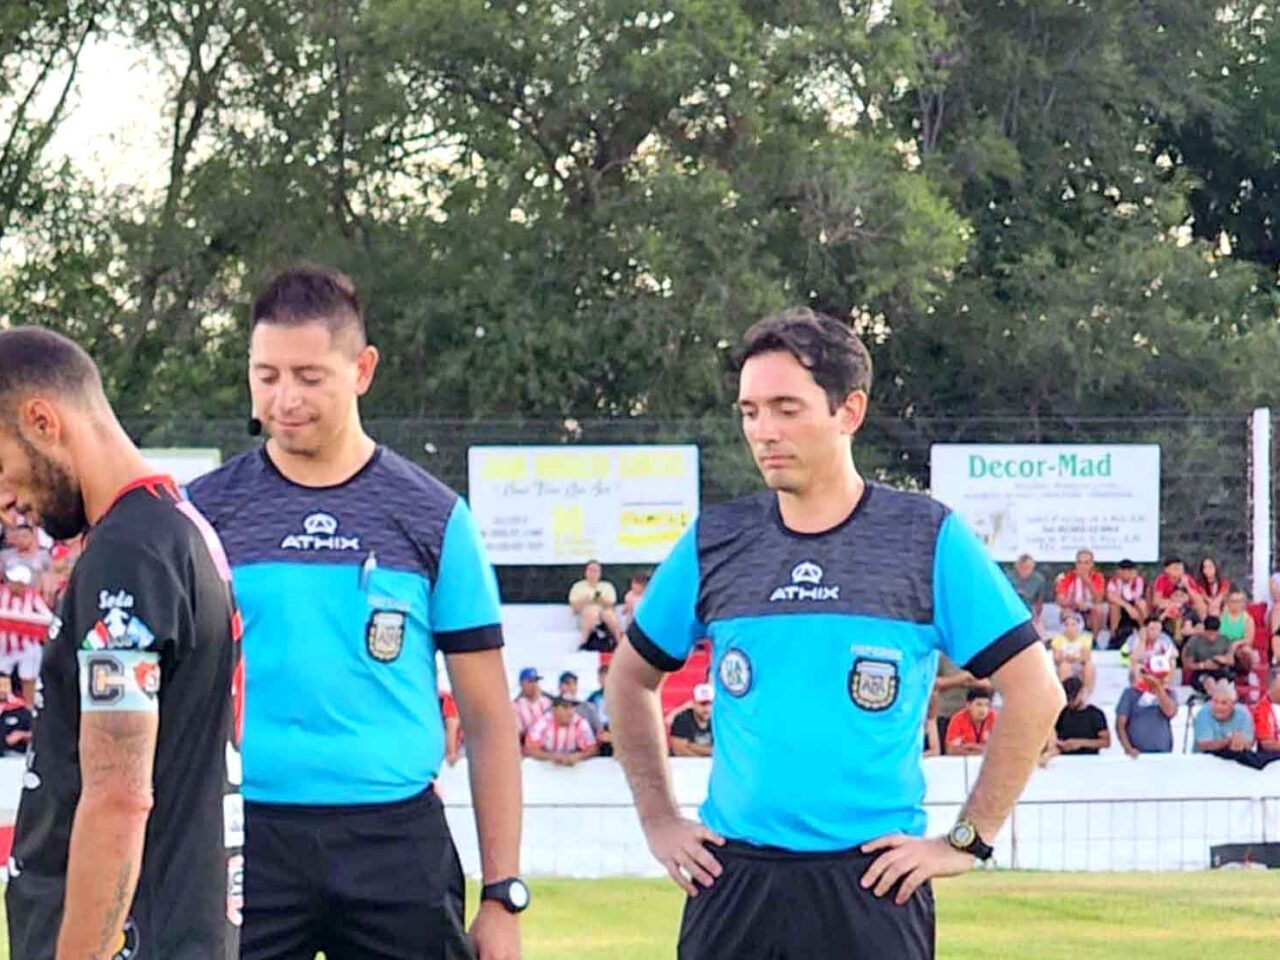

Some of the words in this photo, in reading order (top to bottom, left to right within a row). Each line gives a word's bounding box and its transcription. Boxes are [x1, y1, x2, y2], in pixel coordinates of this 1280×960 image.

[968, 453, 1113, 478] Decor-Mad
[280, 535, 360, 550] ATHIX
[770, 586, 840, 601] ATHIX
